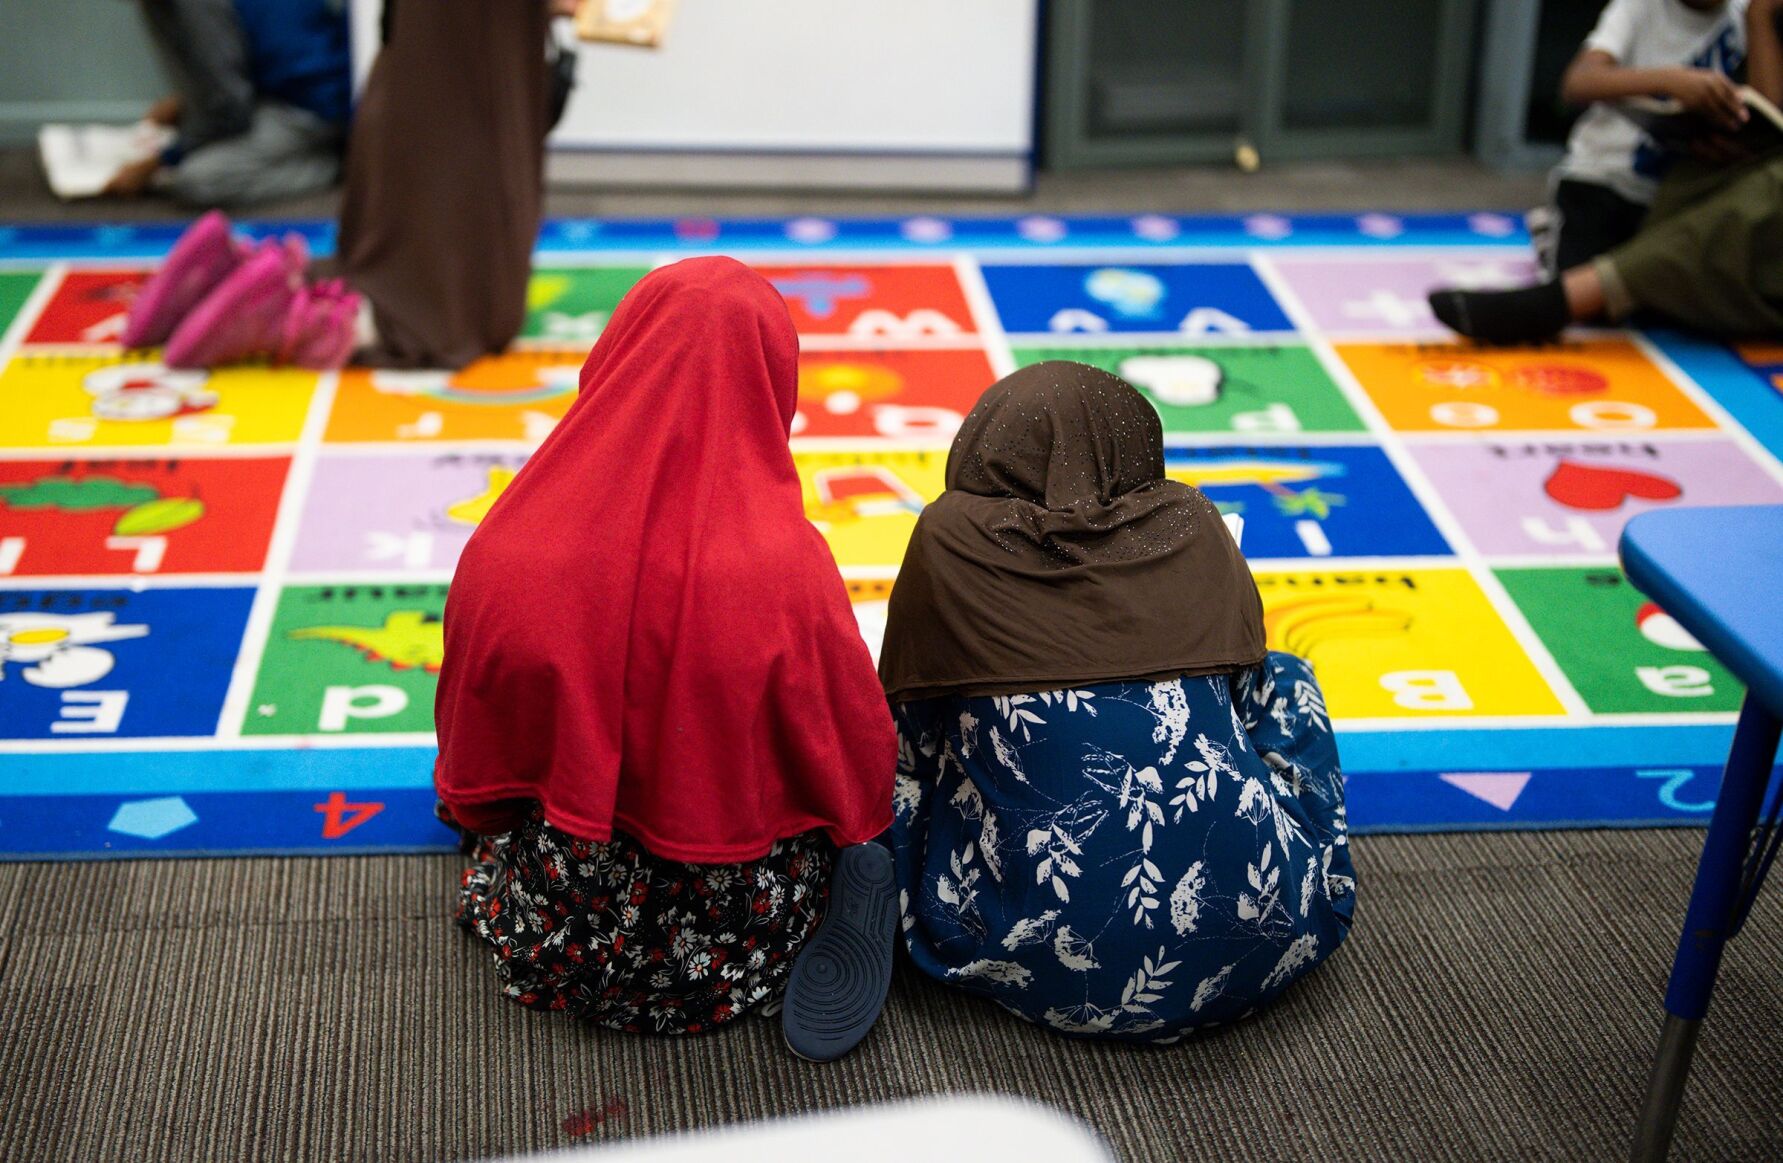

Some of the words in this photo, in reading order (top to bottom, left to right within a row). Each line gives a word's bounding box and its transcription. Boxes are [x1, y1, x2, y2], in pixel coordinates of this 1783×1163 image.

[1569, 401, 1658, 430] O
[106, 536, 167, 573] L
[1378, 669, 1474, 710] B
[1634, 665, 1715, 697] a
[50, 690, 129, 733] E
[318, 685, 408, 731] d
[1636, 770, 1715, 812] 2
[314, 792, 385, 839] 4
